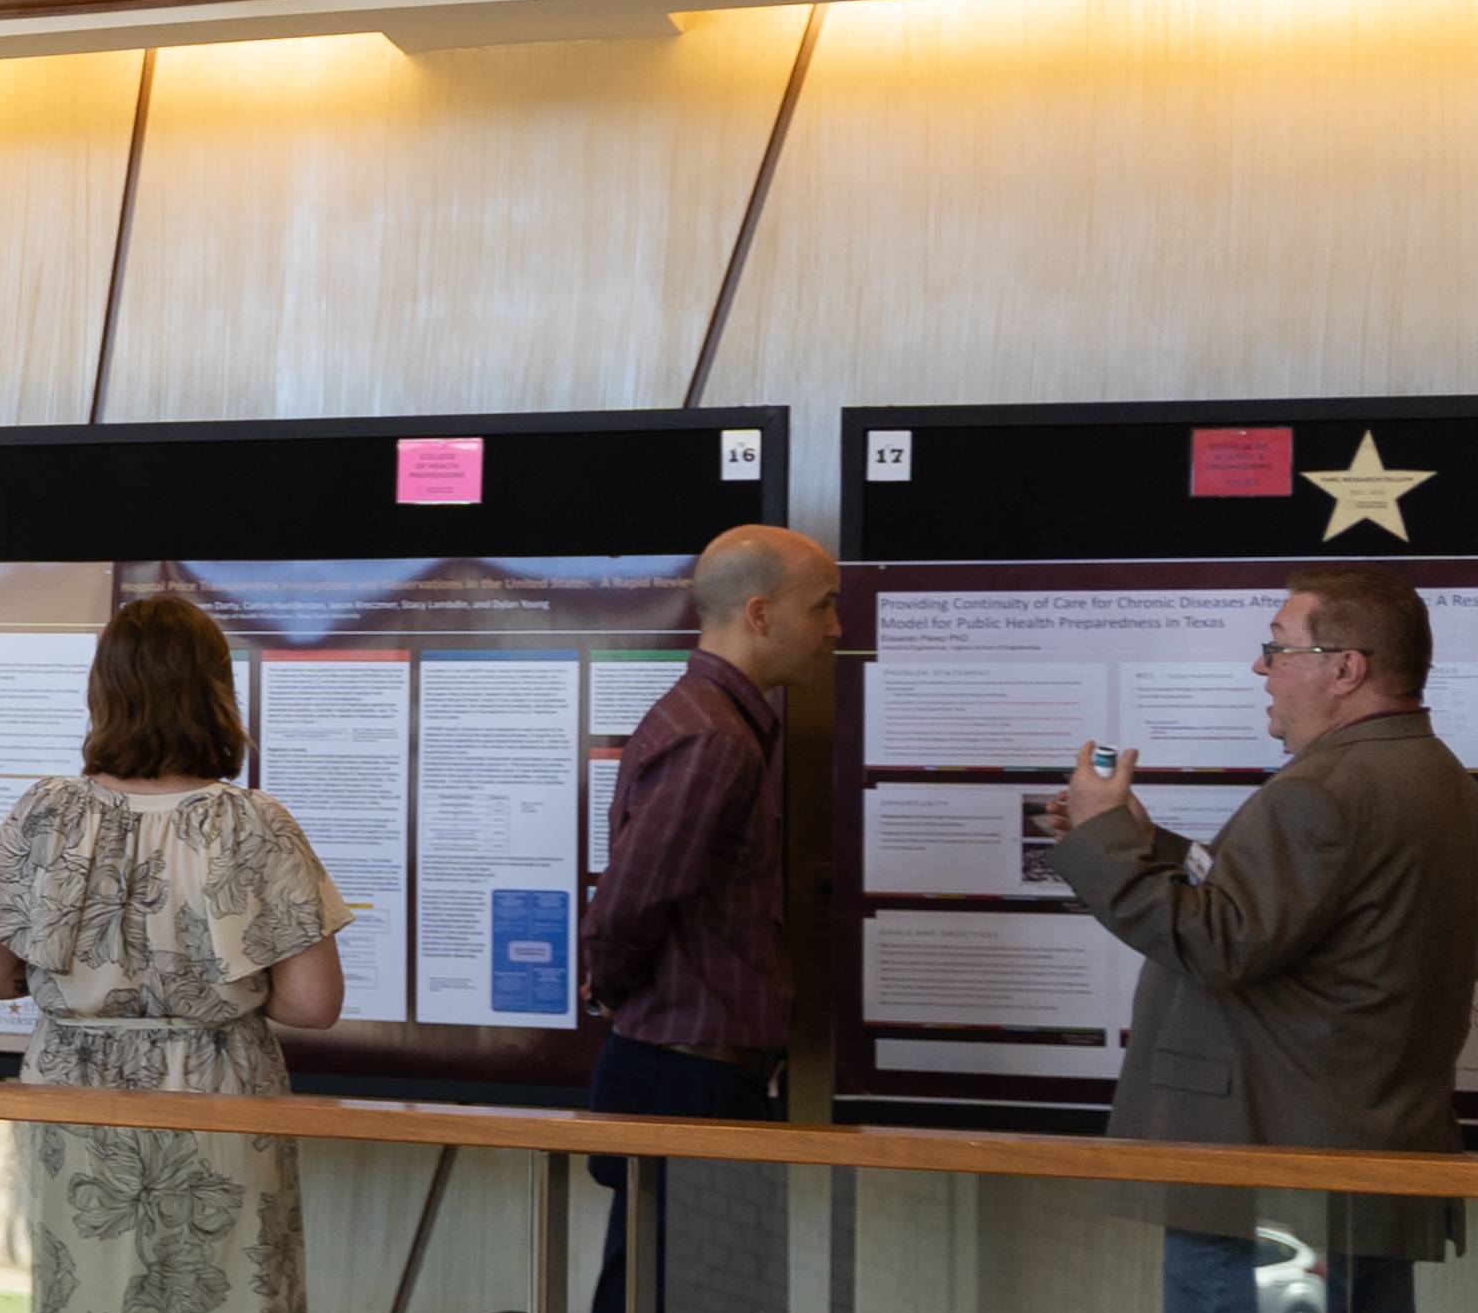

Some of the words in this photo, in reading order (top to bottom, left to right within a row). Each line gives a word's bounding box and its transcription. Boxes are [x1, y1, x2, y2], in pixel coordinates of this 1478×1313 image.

[728, 448, 756, 463] 16
[874, 448, 904, 463] 17
[480, 579, 502, 589] the
[505, 578, 549, 589] United
[612, 578, 651, 590] Rapid
[402, 601, 425, 612] Stacy
[473, 600, 491, 610] and
[492, 600, 519, 611] Dylan
[520, 599, 551, 610] Young
[880, 597, 949, 613] Providing
[953, 597, 1030, 613] Continuity
[1033, 597, 1049, 610] of
[1054, 597, 1088, 610] Care
[1090, 596, 1113, 609] for
[1116, 596, 1170, 609] Chronic
[1178, 596, 1245, 608] Diseases
[1435, 595, 1448, 607] A
[880, 617, 928, 630] Model
[931, 617, 952, 629] for
[957, 617, 1001, 630] Public
[1005, 617, 1054, 630] Health
[1059, 617, 1163, 632] Preparedness
[1165, 617, 1179, 628] in
[1184, 616, 1224, 628] Texas
